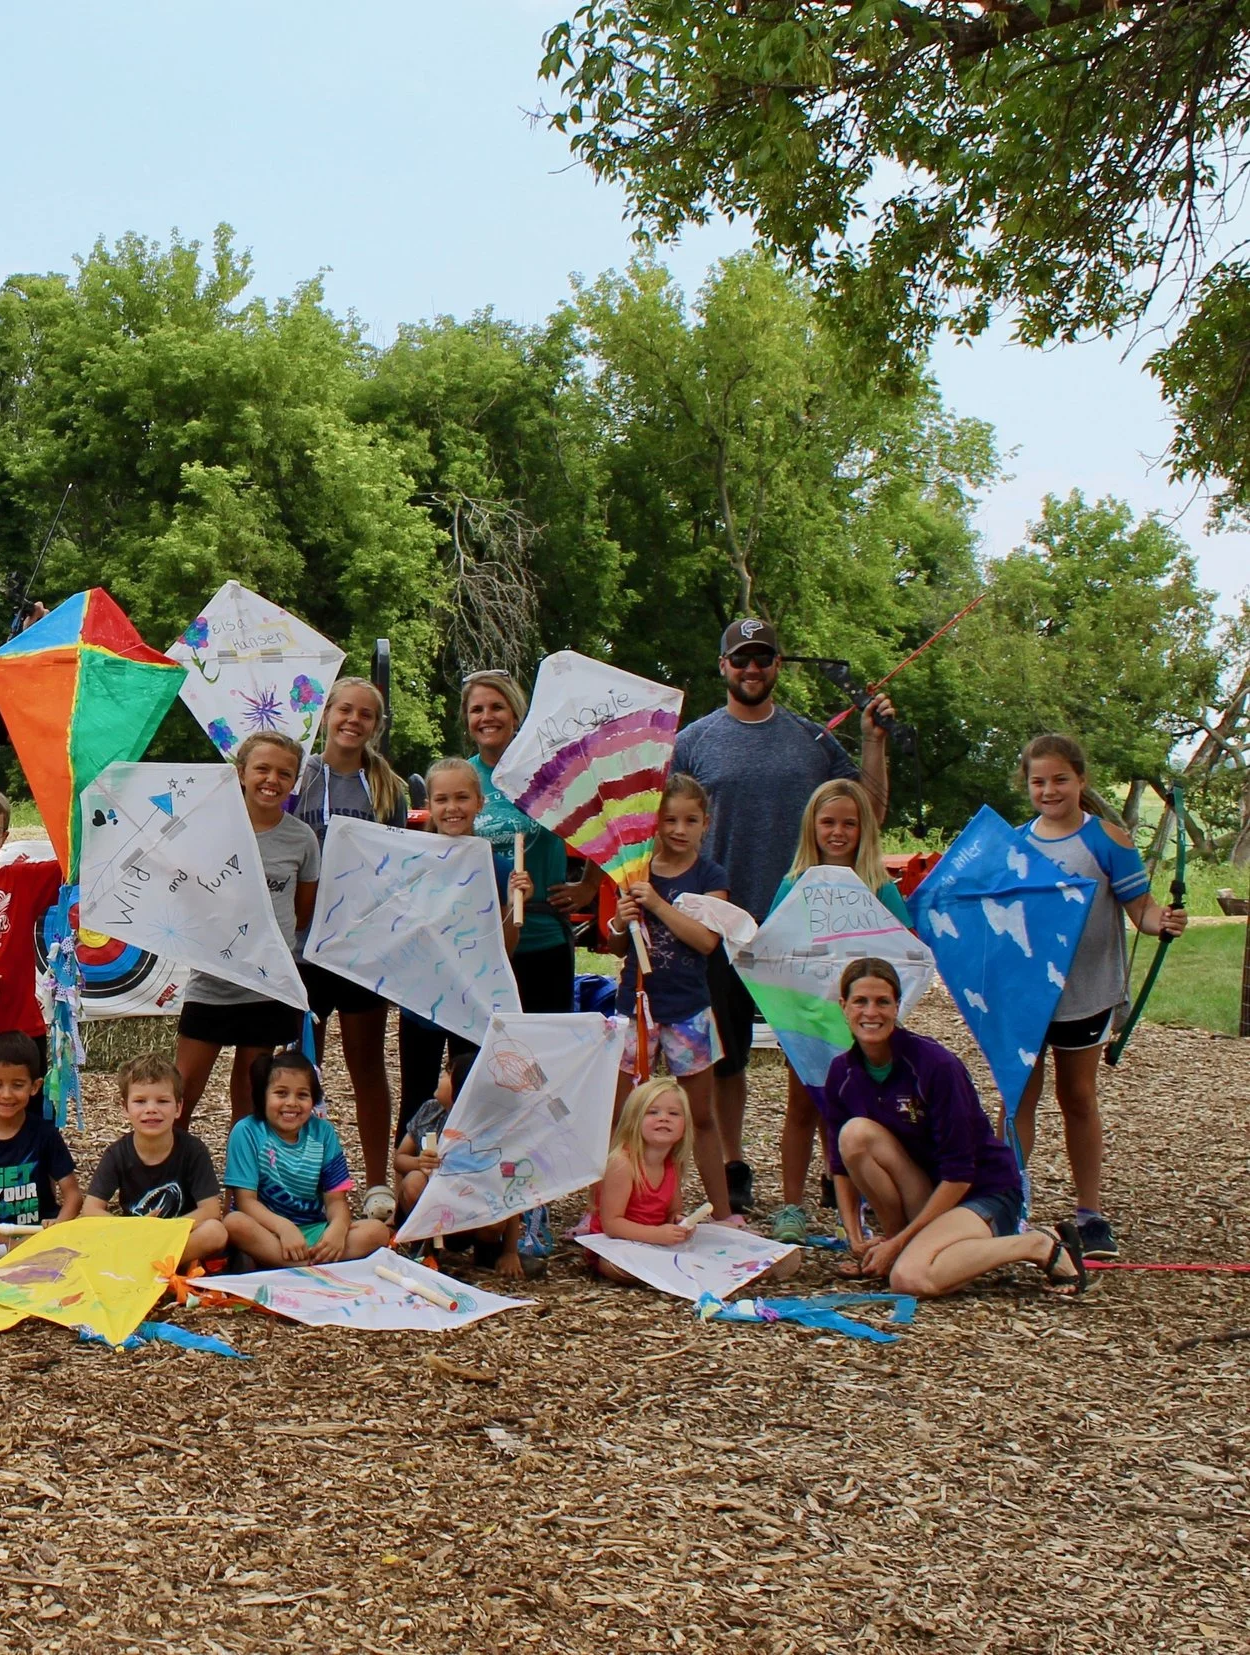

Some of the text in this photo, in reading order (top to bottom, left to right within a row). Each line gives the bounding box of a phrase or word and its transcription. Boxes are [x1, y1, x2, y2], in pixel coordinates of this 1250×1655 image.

[231, 631, 291, 651] Hansen
[105, 865, 151, 925] Wild
[168, 868, 188, 893] and
[16, 1210, 39, 1225] ON
